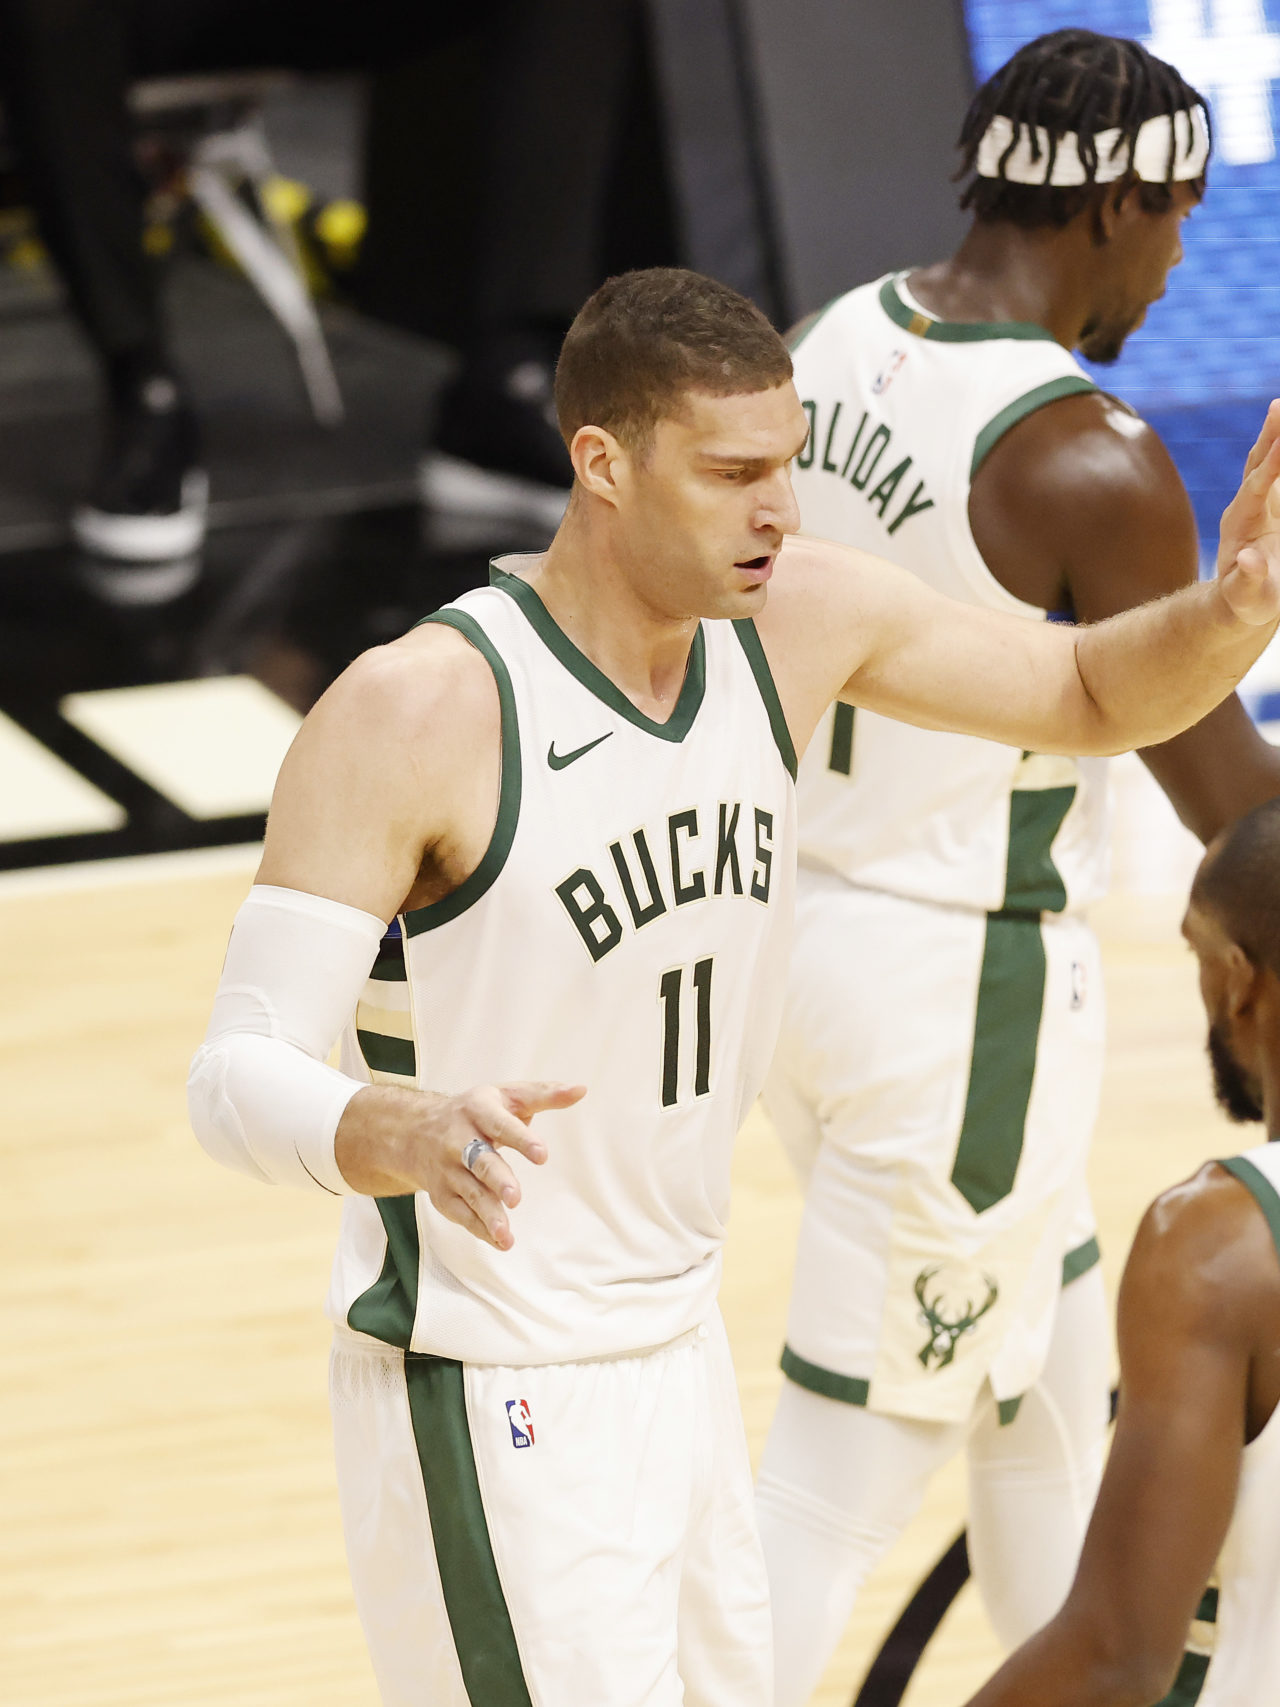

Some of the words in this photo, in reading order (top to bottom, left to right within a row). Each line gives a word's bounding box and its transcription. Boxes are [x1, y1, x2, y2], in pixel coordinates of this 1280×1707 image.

[797, 400, 936, 536] OLIDAY
[552, 800, 776, 967] BUCKS
[657, 954, 717, 1112] 11
